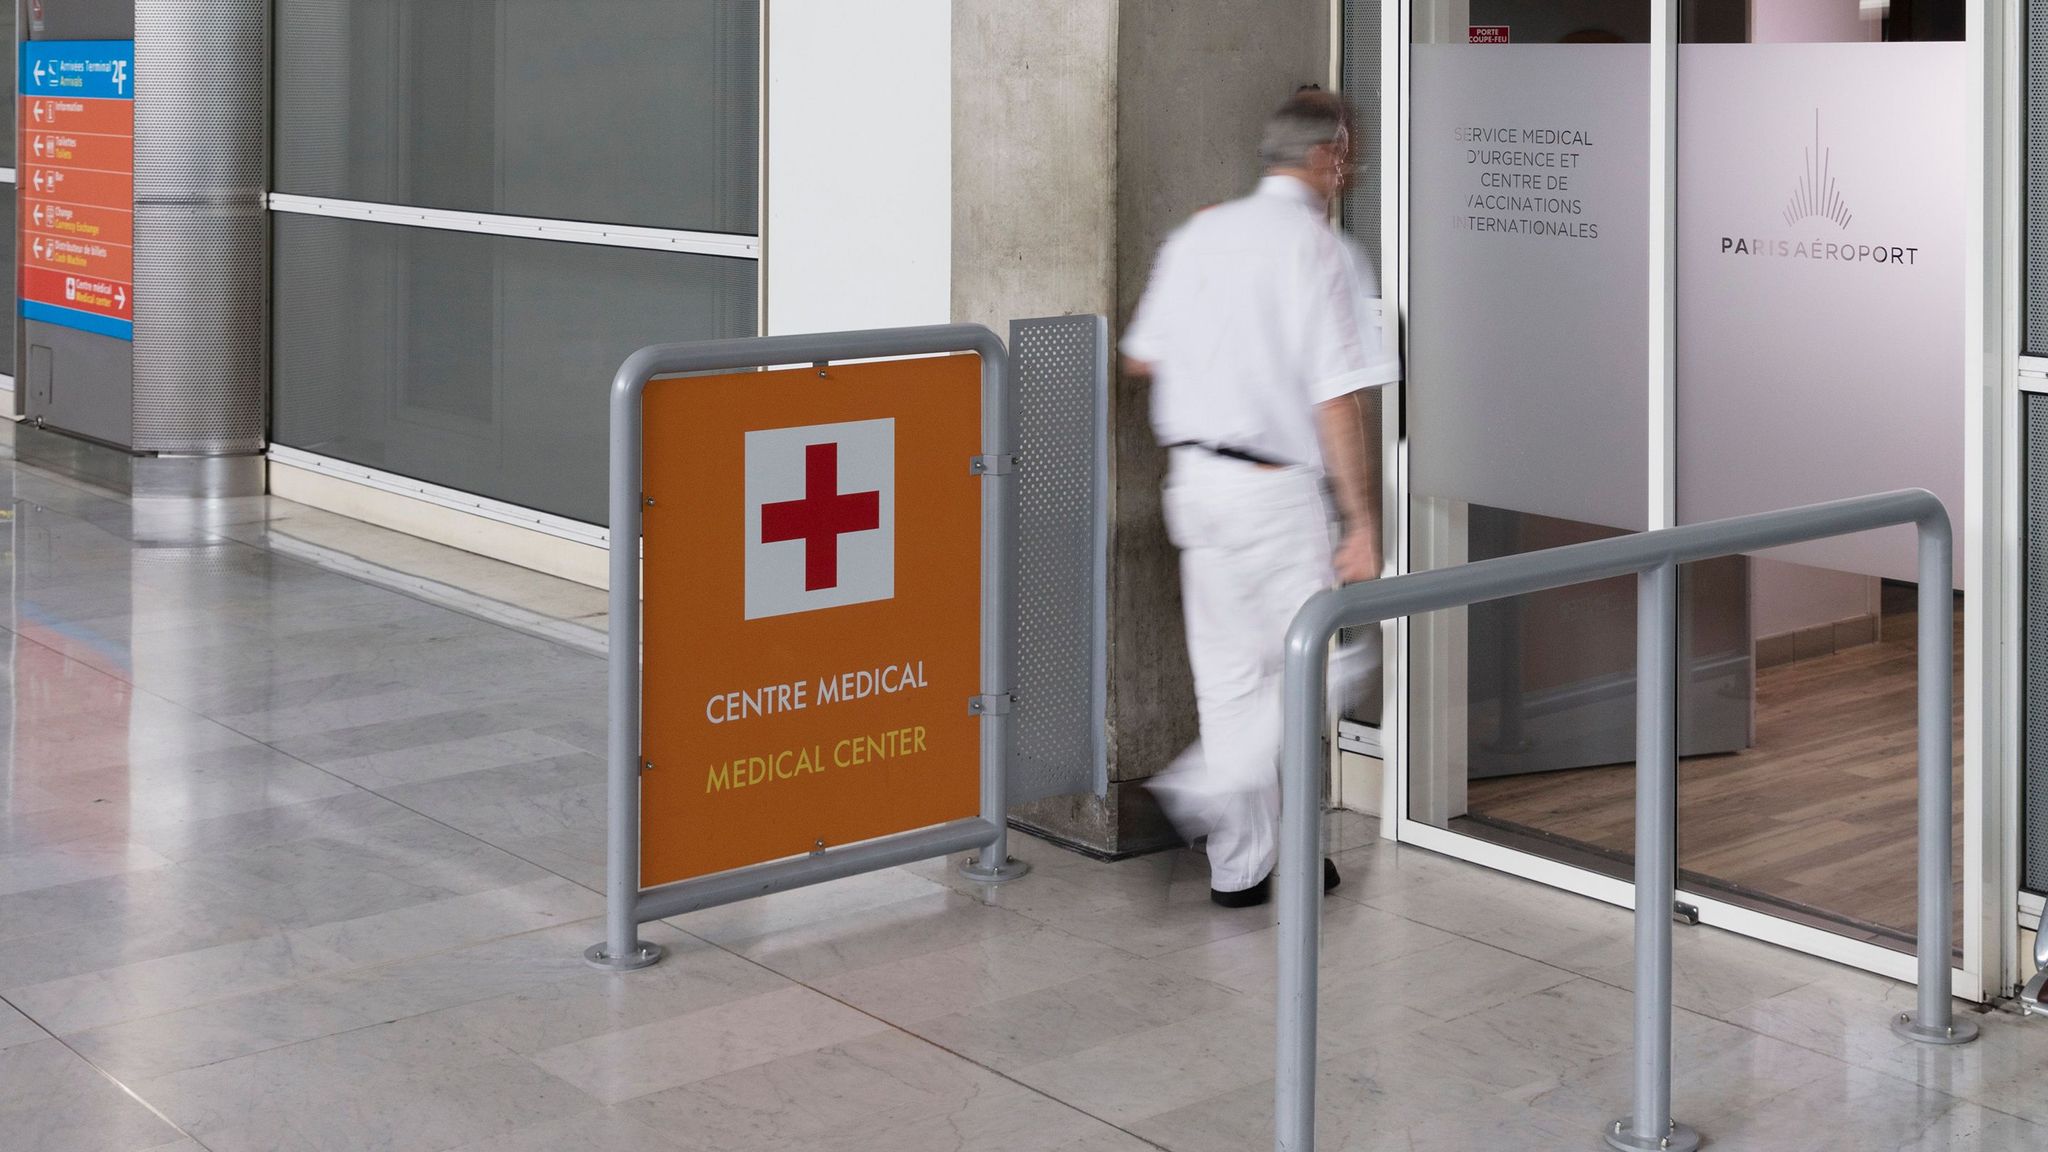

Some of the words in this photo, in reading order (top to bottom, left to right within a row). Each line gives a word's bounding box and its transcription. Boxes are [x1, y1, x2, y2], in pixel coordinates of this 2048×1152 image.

[1469, 35, 1507, 43] COUPE-FEU
[1476, 28, 1499, 36] PORTE
[60, 75, 83, 87] Arrivals
[85, 60, 112, 73] Terminal
[112, 60, 127, 95] 2F
[55, 101, 84, 112] Information
[55, 136, 76, 147] Toilettes
[1454, 127, 1518, 143] SERVICE
[1522, 129, 1593, 146] MEDICAL
[55, 148, 72, 160] Toilets
[1467, 149, 1555, 167] D'URGENCE
[1560, 153, 1580, 168] ET
[55, 171, 64, 181] Bar
[1480, 172, 1542, 190] CENTRE
[1547, 175, 1568, 191] DE
[55, 206, 73, 220] Change
[1465, 194, 1582, 215] VACCINATIONS
[55, 218, 76, 233] Currency
[76, 221, 99, 235] Exchange
[1453, 215, 1599, 239] INTERNATIONALES
[55, 240, 84, 253] Distributeur
[84, 244, 91, 255] de
[91, 246, 107, 258] billets
[55, 252, 66, 263] Cash
[67, 254, 87, 266] Machine
[76, 279, 92, 291] Centre
[92, 283, 112, 295] médical
[76, 291, 95, 304] Medical
[95, 296, 112, 308] center
[706, 680, 808, 724] CENTRE
[816, 660, 928, 706] MEDICAL
[705, 745, 825, 793] MEDICAL
[833, 725, 927, 768] CENTER
